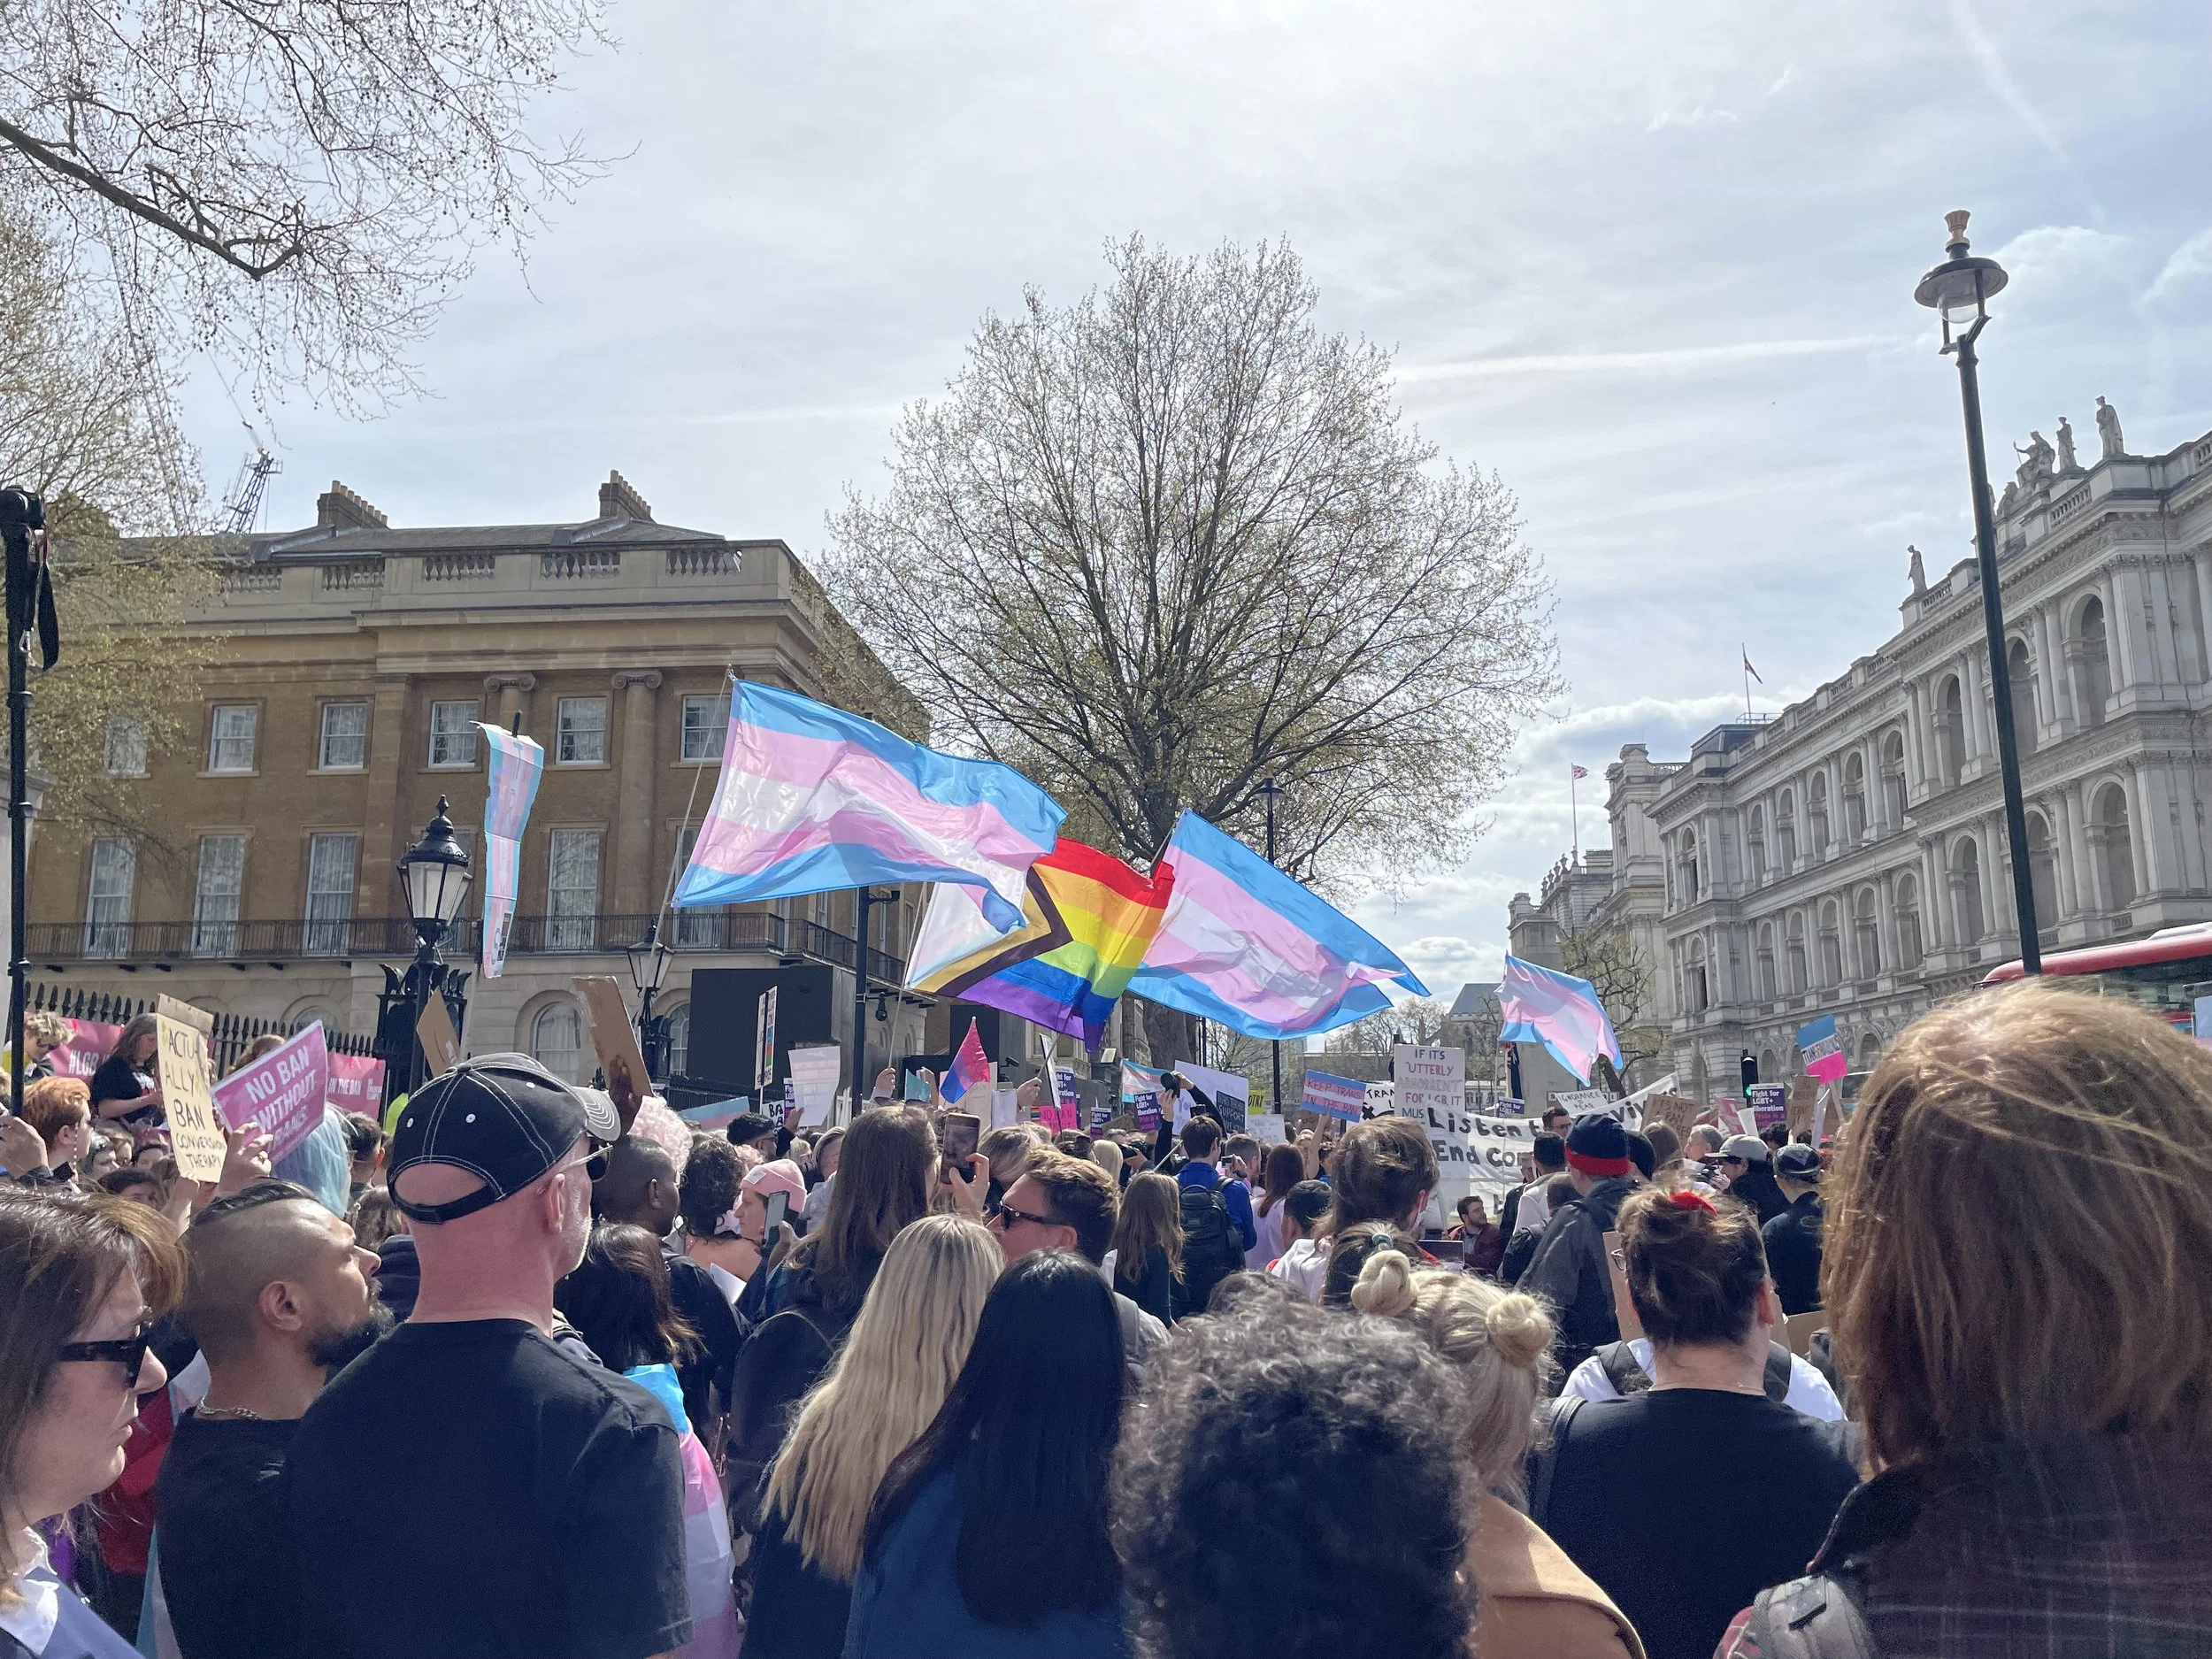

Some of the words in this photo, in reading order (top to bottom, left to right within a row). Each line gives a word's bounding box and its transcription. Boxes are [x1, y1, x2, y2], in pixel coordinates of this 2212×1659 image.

[1415, 1049, 1425, 1059] IF
[1429, 1050, 1446, 1060] IT'S
[245, 1071, 276, 1104] NO
[276, 1045, 310, 1085] BAN
[1405, 1062, 1455, 1076] UTTERLY
[165, 1064, 196, 1097] ALLY
[1307, 1079, 1332, 1092] KEEP
[1337, 1087, 1362, 1099] TRANS
[251, 1069, 316, 1134] WITHOUT
[1305, 1094, 1317, 1105] IN
[1323, 1098, 1340, 1110] THE
[1366, 1089, 1394, 1099] TRAN
[1451, 1096, 1462, 1106] IT
[173, 1099, 206, 1132] BAN
[1218, 1104, 1245, 1122] SUPPORT
[1402, 1108, 1425, 1118] MUS
[1427, 1107, 1522, 1137] Listen
[1528, 1120, 1542, 1137] t
[176, 1135, 227, 1150] CONVERSION
[1432, 1140, 1480, 1165] End
